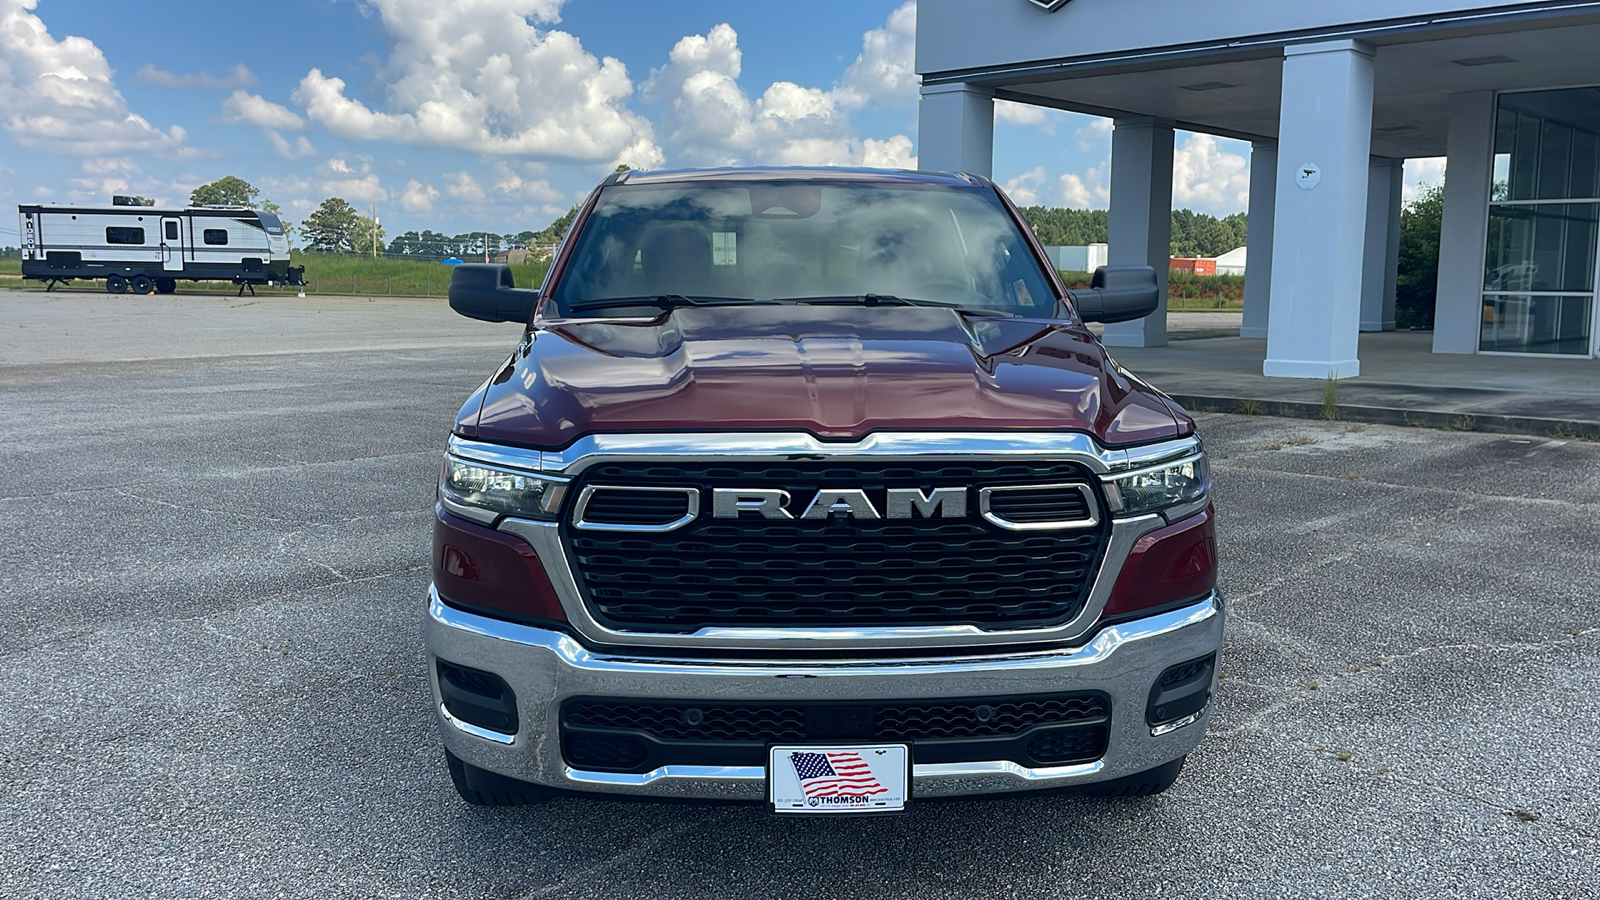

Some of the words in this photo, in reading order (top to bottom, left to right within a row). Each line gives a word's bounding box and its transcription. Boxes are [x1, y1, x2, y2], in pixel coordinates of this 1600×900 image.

[26, 217, 35, 255] HIDOUT
[712, 486, 968, 520] RAM
[820, 795, 869, 804] THOMSON
